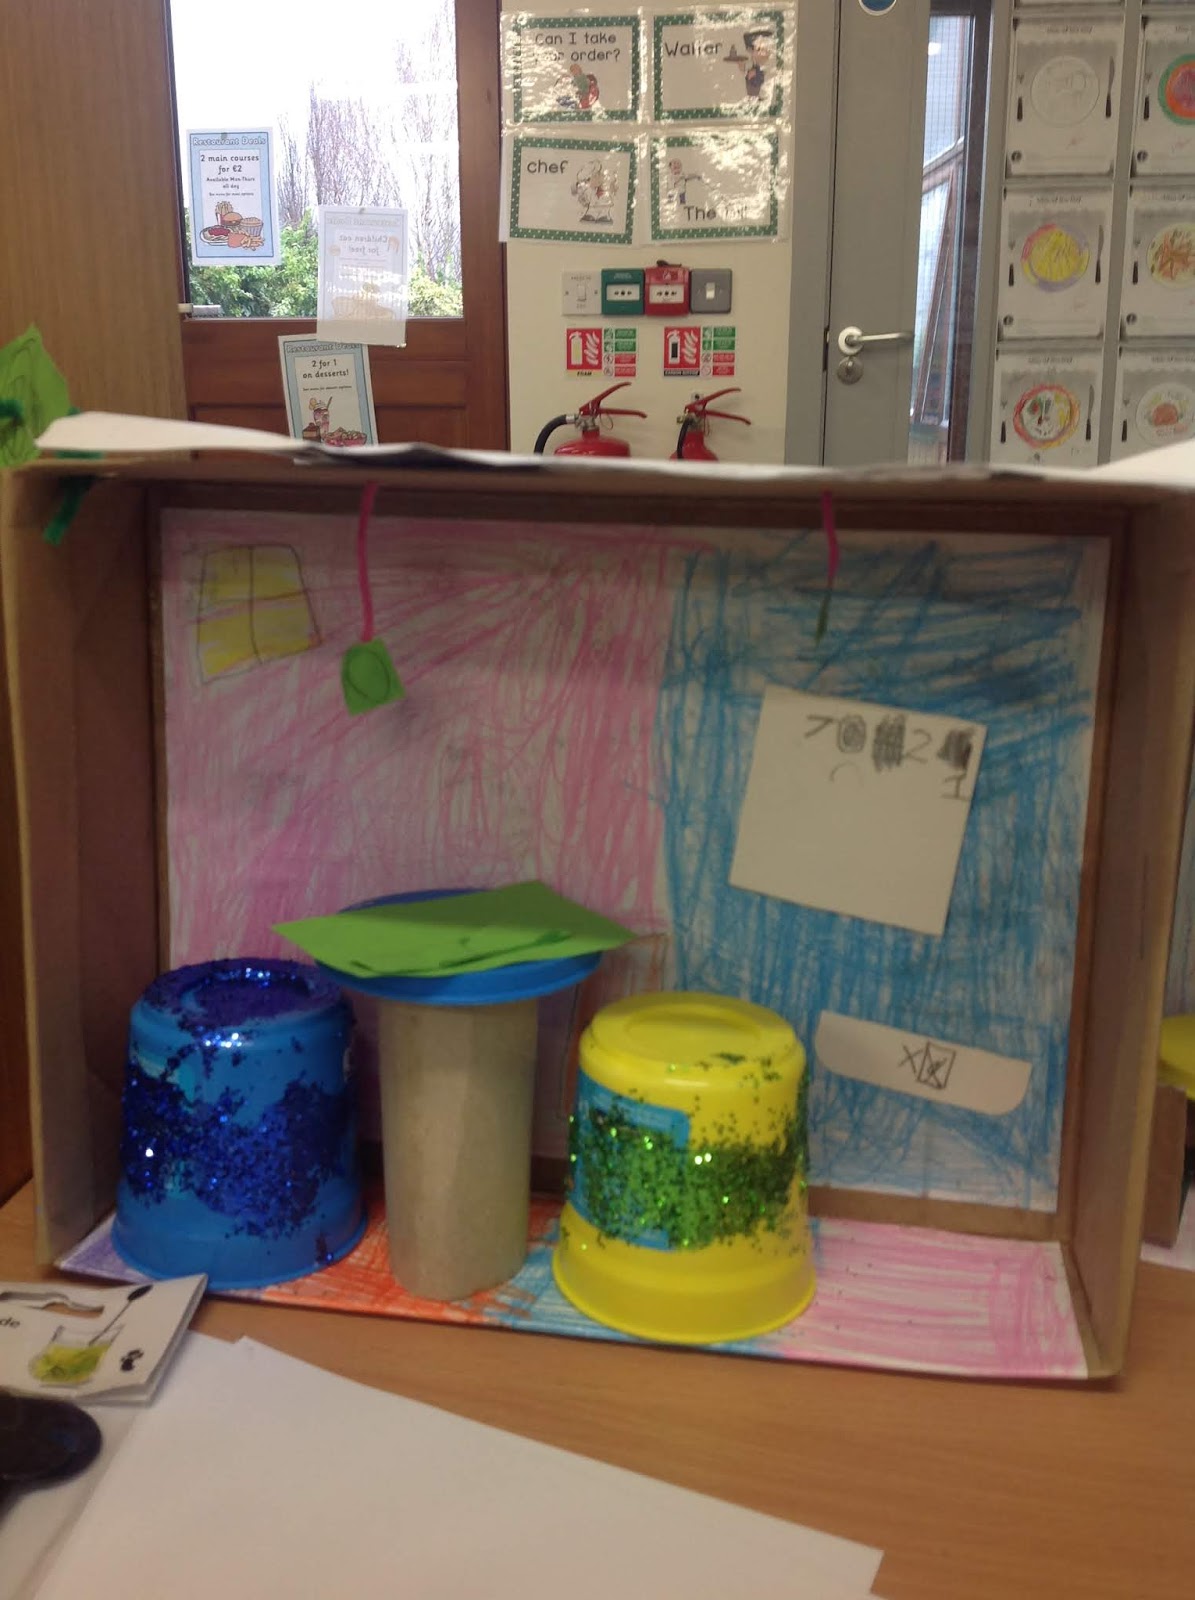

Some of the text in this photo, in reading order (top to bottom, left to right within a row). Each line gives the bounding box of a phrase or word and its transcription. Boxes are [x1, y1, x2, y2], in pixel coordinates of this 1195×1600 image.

[535, 31, 617, 45] Can I take
[570, 48, 621, 62] order?
[193, 136, 266, 146] Restaurant Deals
[200, 154, 206, 162] 2
[208, 154, 228, 162] main
[218, 165, 242, 175] for €2
[527, 159, 569, 174] chef
[683, 206, 717, 221] The
[311, 360, 317, 368] 2
[319, 359, 330, 369] for
[314, 368, 349, 378] desserts!
